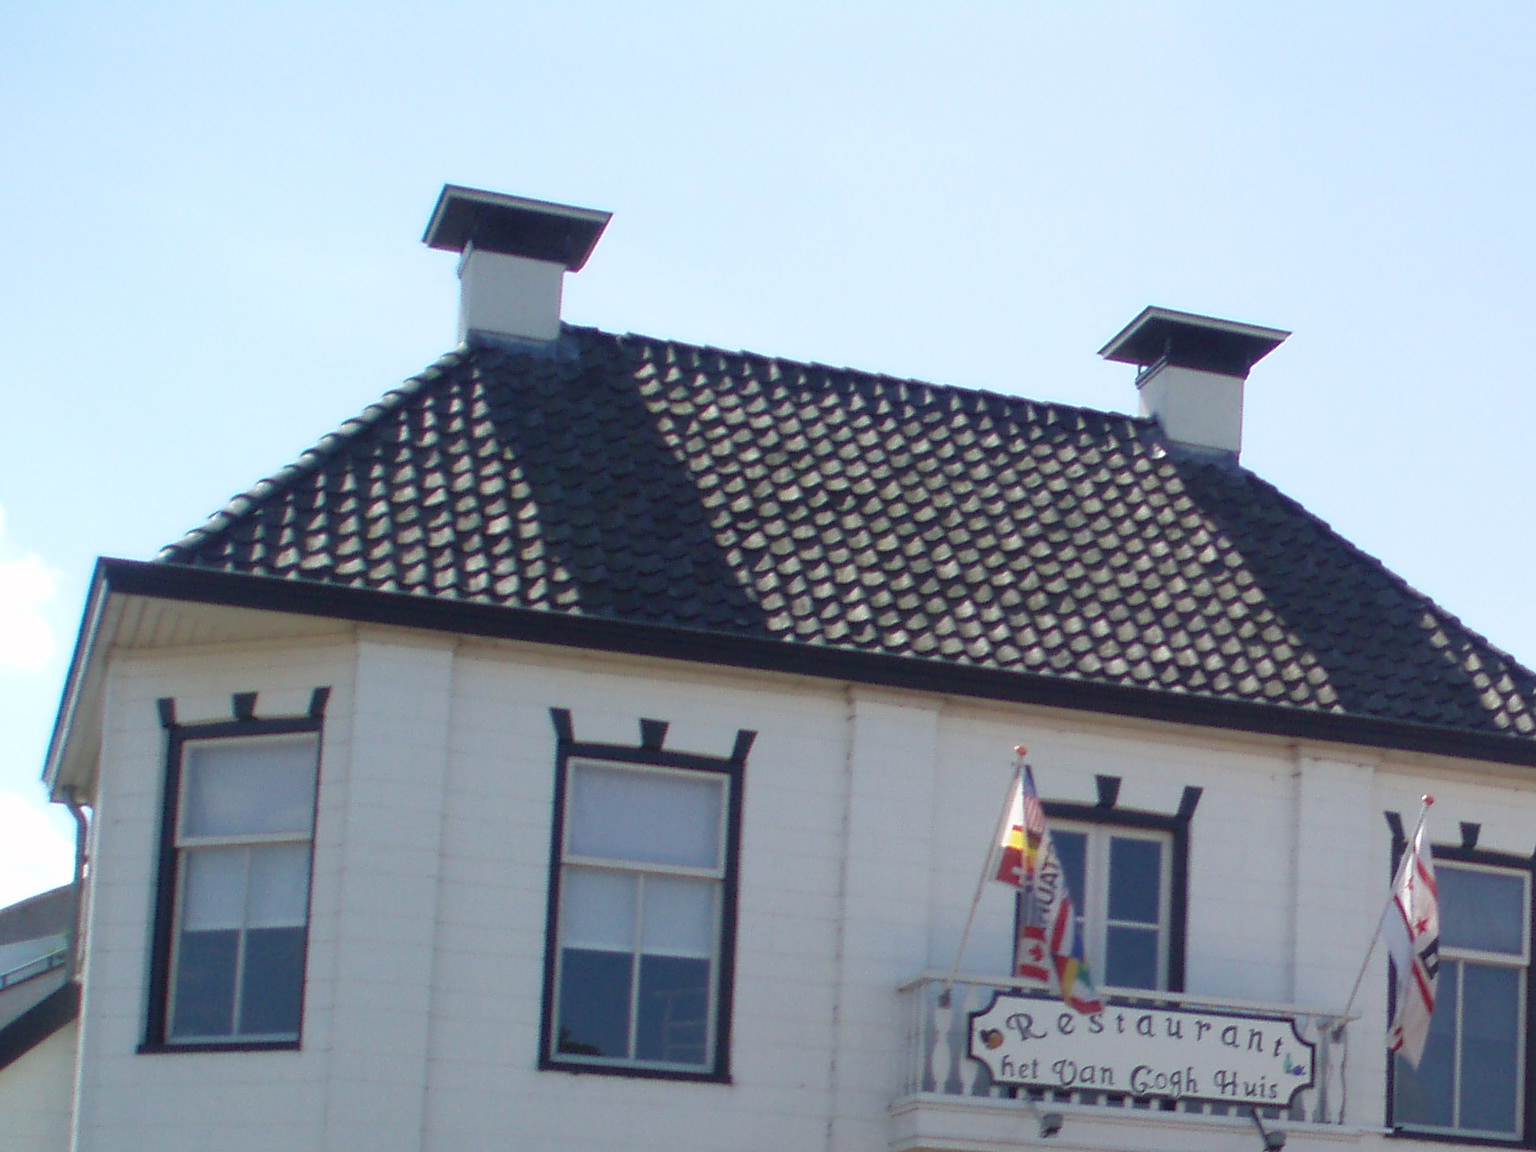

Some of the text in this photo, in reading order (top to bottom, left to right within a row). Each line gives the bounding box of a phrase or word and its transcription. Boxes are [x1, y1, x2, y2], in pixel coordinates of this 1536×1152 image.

[1005, 1012, 1286, 1058] Restaurant
[1001, 1054, 1279, 1100] het Van Gogh Huis
